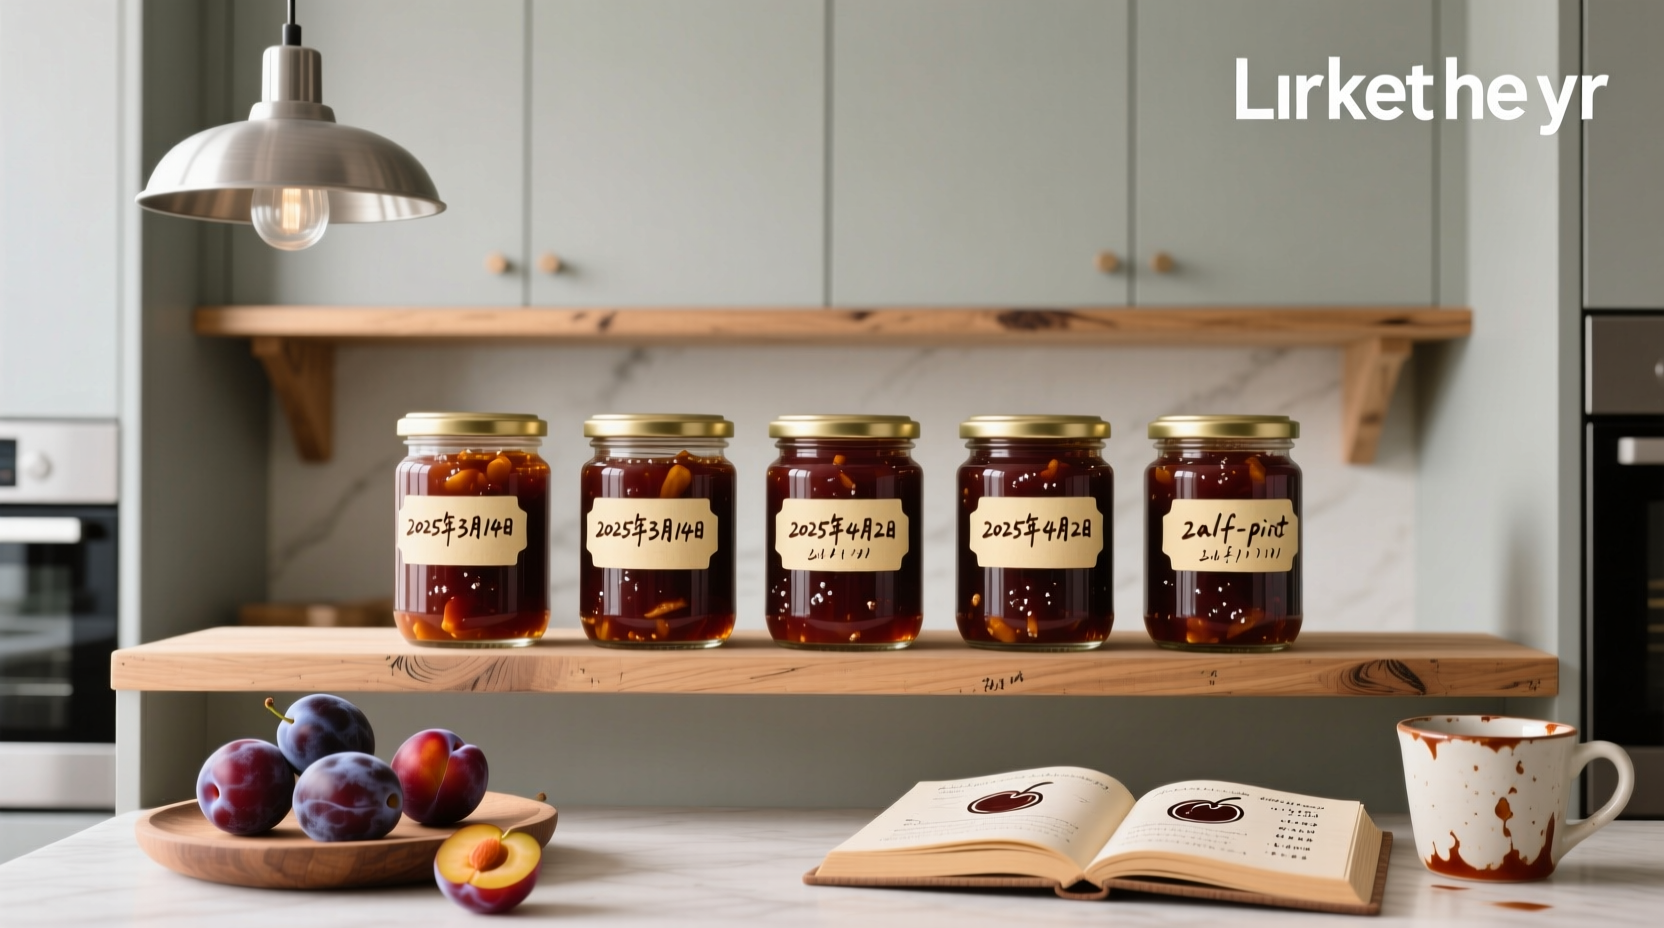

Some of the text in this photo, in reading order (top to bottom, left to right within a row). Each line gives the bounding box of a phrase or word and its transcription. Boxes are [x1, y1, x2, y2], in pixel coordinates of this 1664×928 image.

[406, 511, 514, 547] 2025年3月14日
[595, 513, 705, 548] 2025年3月14日
[788, 513, 896, 546] 2025年4月2日
[982, 512, 1092, 548] 2025年4月2日
